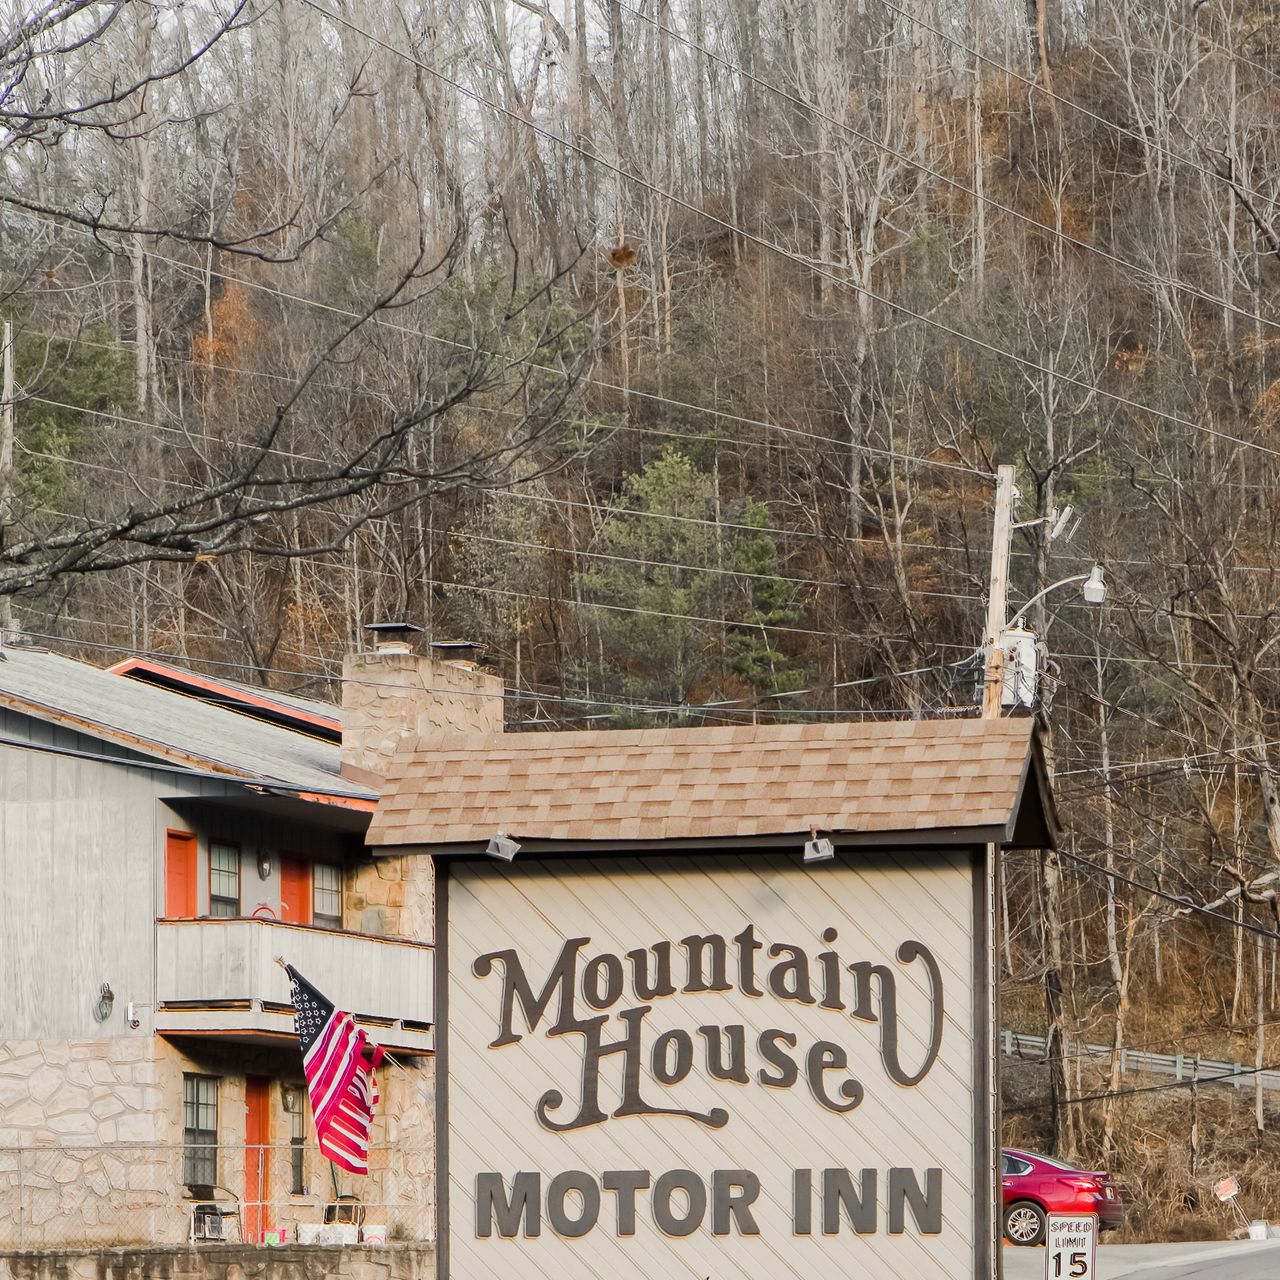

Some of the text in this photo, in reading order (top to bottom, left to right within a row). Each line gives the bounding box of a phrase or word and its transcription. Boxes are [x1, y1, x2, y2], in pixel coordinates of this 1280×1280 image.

[471, 924, 945, 1088] Mountain
[535, 1004, 864, 1133] House
[474, 1167, 943, 1239] MOTOR INN
[1050, 1221, 1093, 1233] SPEED
[1052, 1252, 1088, 1278] 15
[1055, 1237, 1087, 1248] LIMIT
